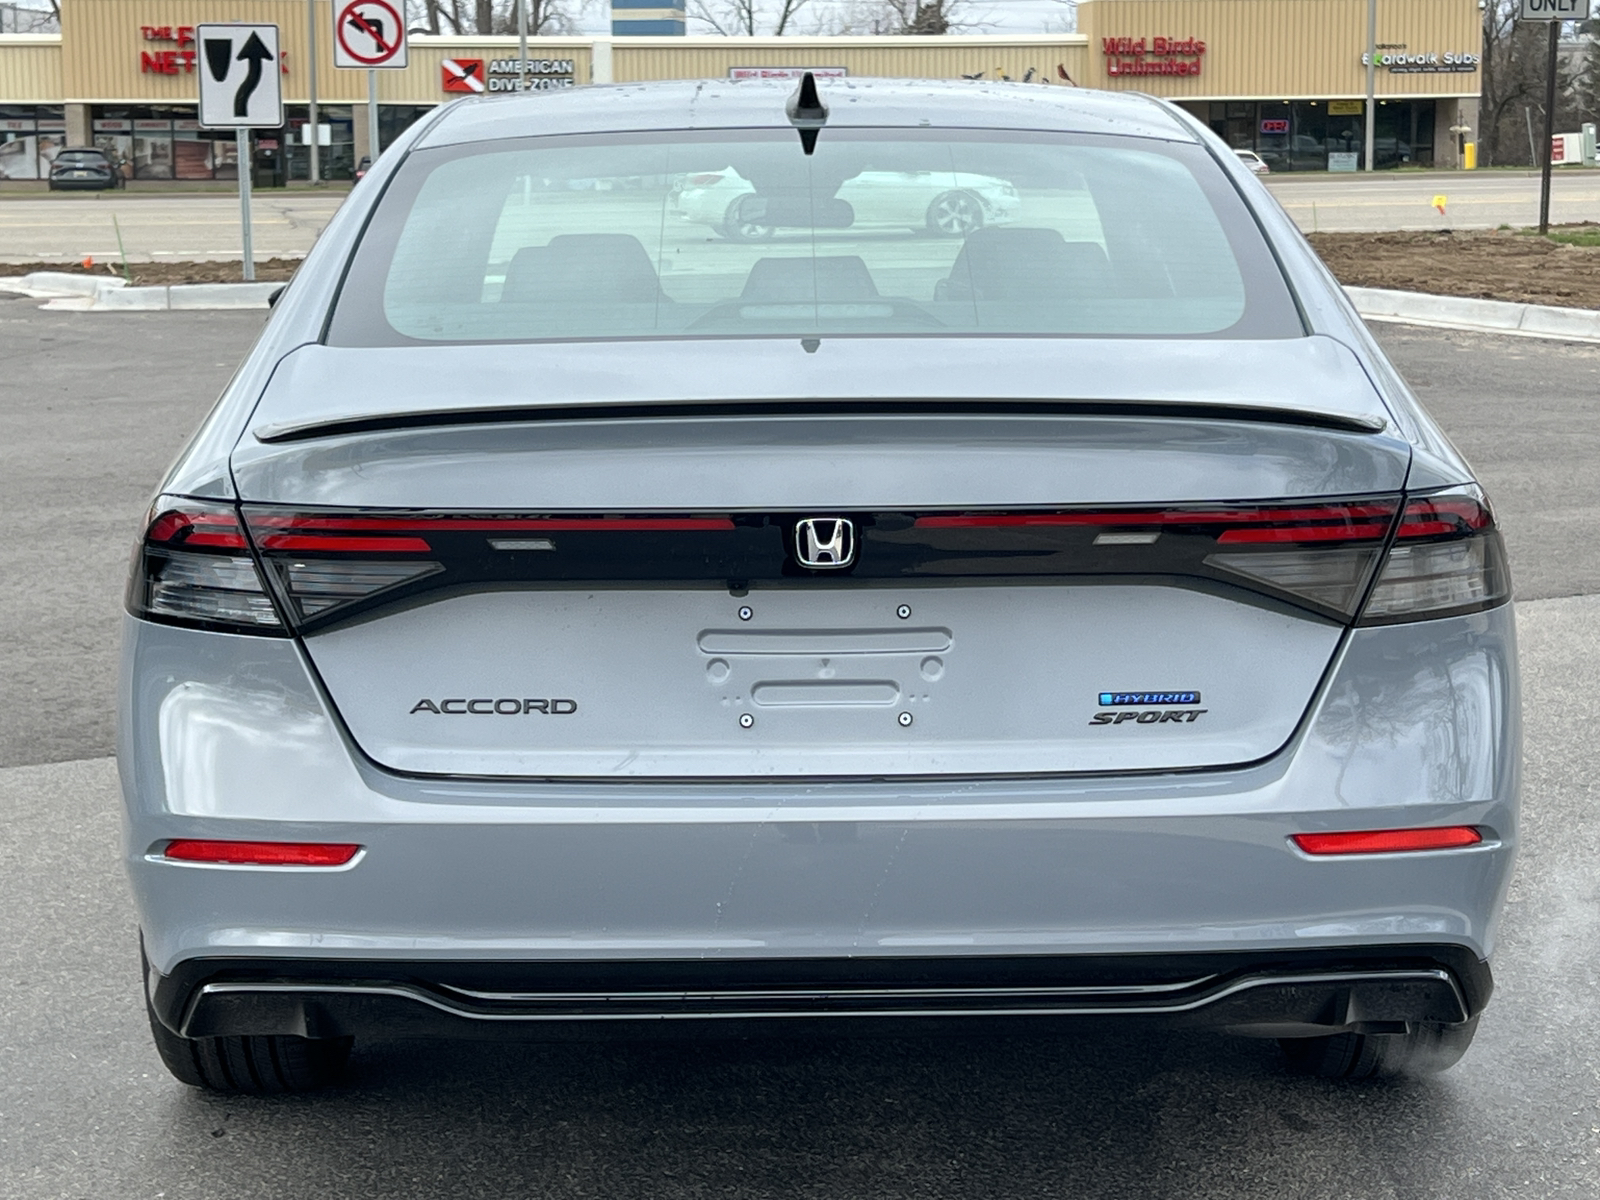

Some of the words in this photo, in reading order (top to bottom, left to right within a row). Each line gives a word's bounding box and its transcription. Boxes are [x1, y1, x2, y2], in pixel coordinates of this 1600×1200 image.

[1530, 0, 1577, 11] ONLY
[1102, 37, 1146, 55] Wild
[1153, 37, 1206, 55] Birds
[1443, 52, 1481, 65] Subs
[489, 60, 573, 73] AMERICAN
[1107, 57, 1201, 76] Unlimited
[1114, 693, 1195, 704] HYBRID
[409, 698, 578, 715] ACCORD
[1088, 709, 1208, 726] SPORT
